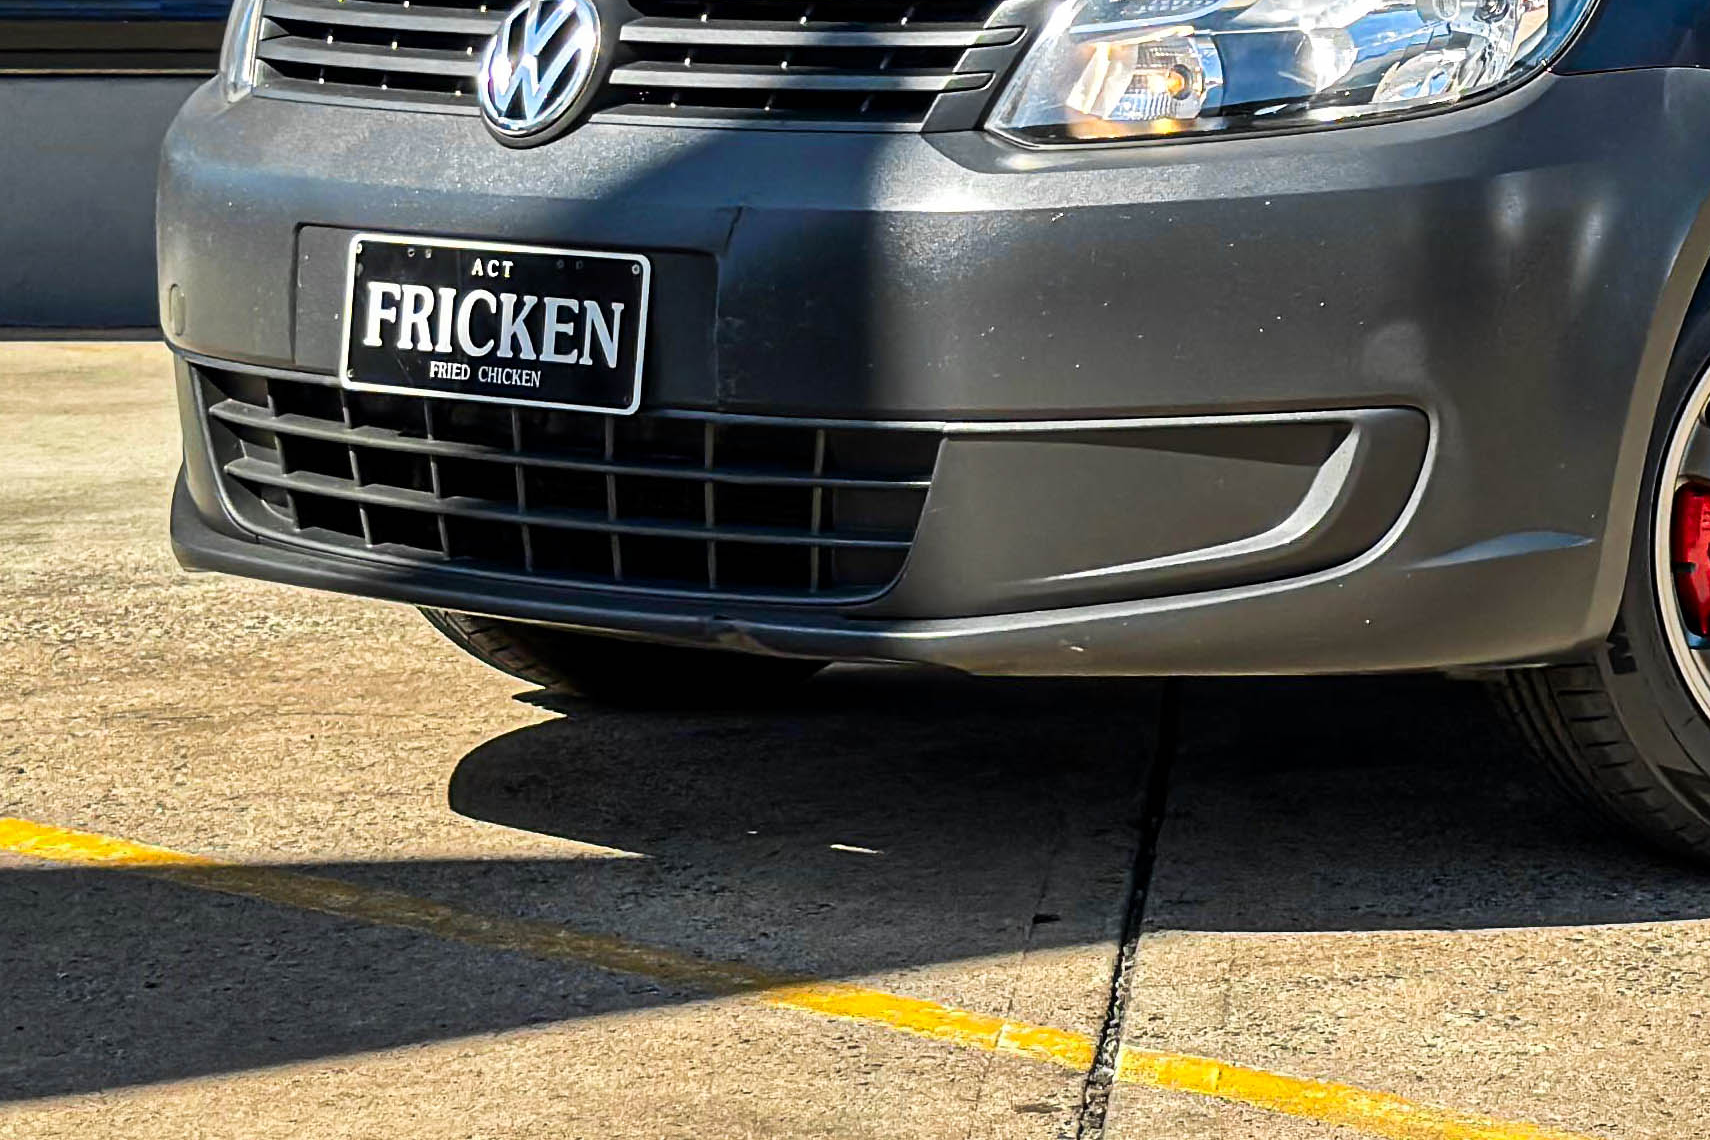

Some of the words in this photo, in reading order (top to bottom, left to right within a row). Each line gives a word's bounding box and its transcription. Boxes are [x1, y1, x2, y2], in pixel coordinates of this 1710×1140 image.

[471, 258, 514, 278] ACT
[363, 281, 625, 369] FRICKEN
[429, 360, 471, 381] FRIED
[478, 366, 541, 388] CHICKEN
